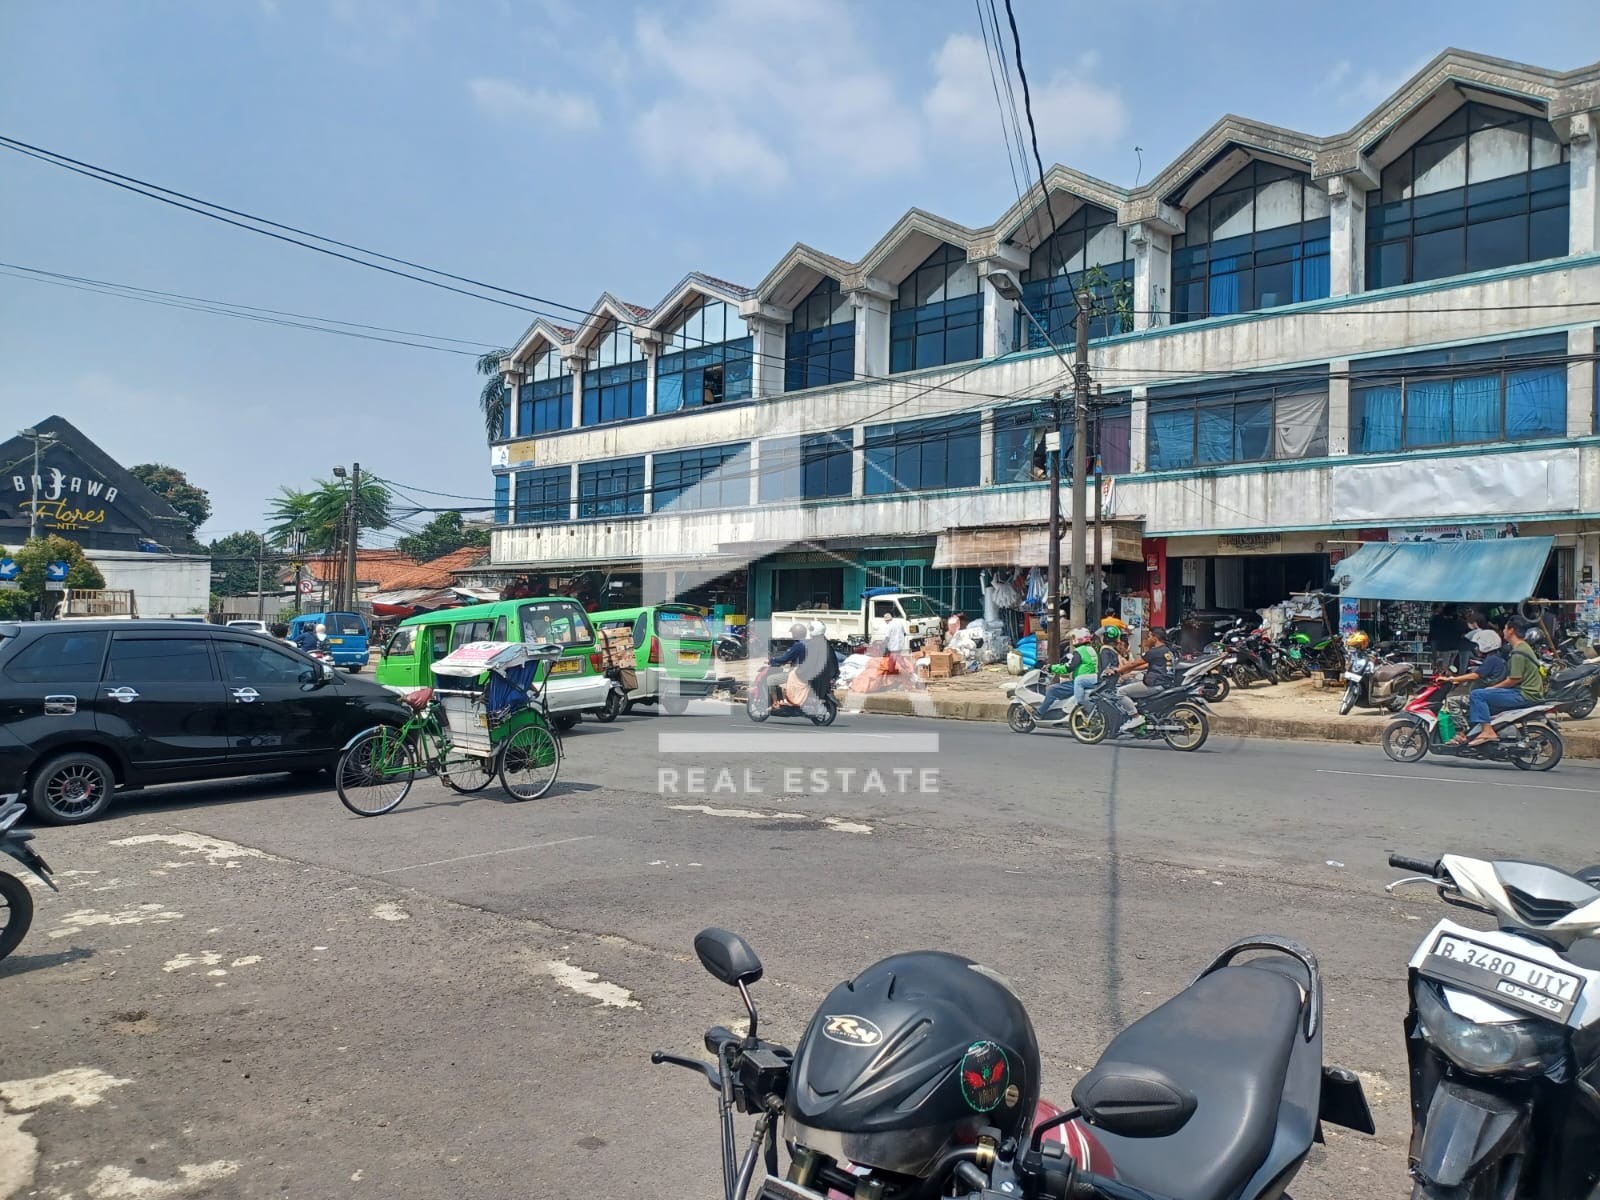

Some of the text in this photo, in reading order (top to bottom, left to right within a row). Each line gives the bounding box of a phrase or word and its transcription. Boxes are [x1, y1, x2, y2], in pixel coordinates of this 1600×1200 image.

[19, 498, 105, 523] Flores
[1442, 942, 1456, 958] B
[1463, 949, 1516, 976] 3480
